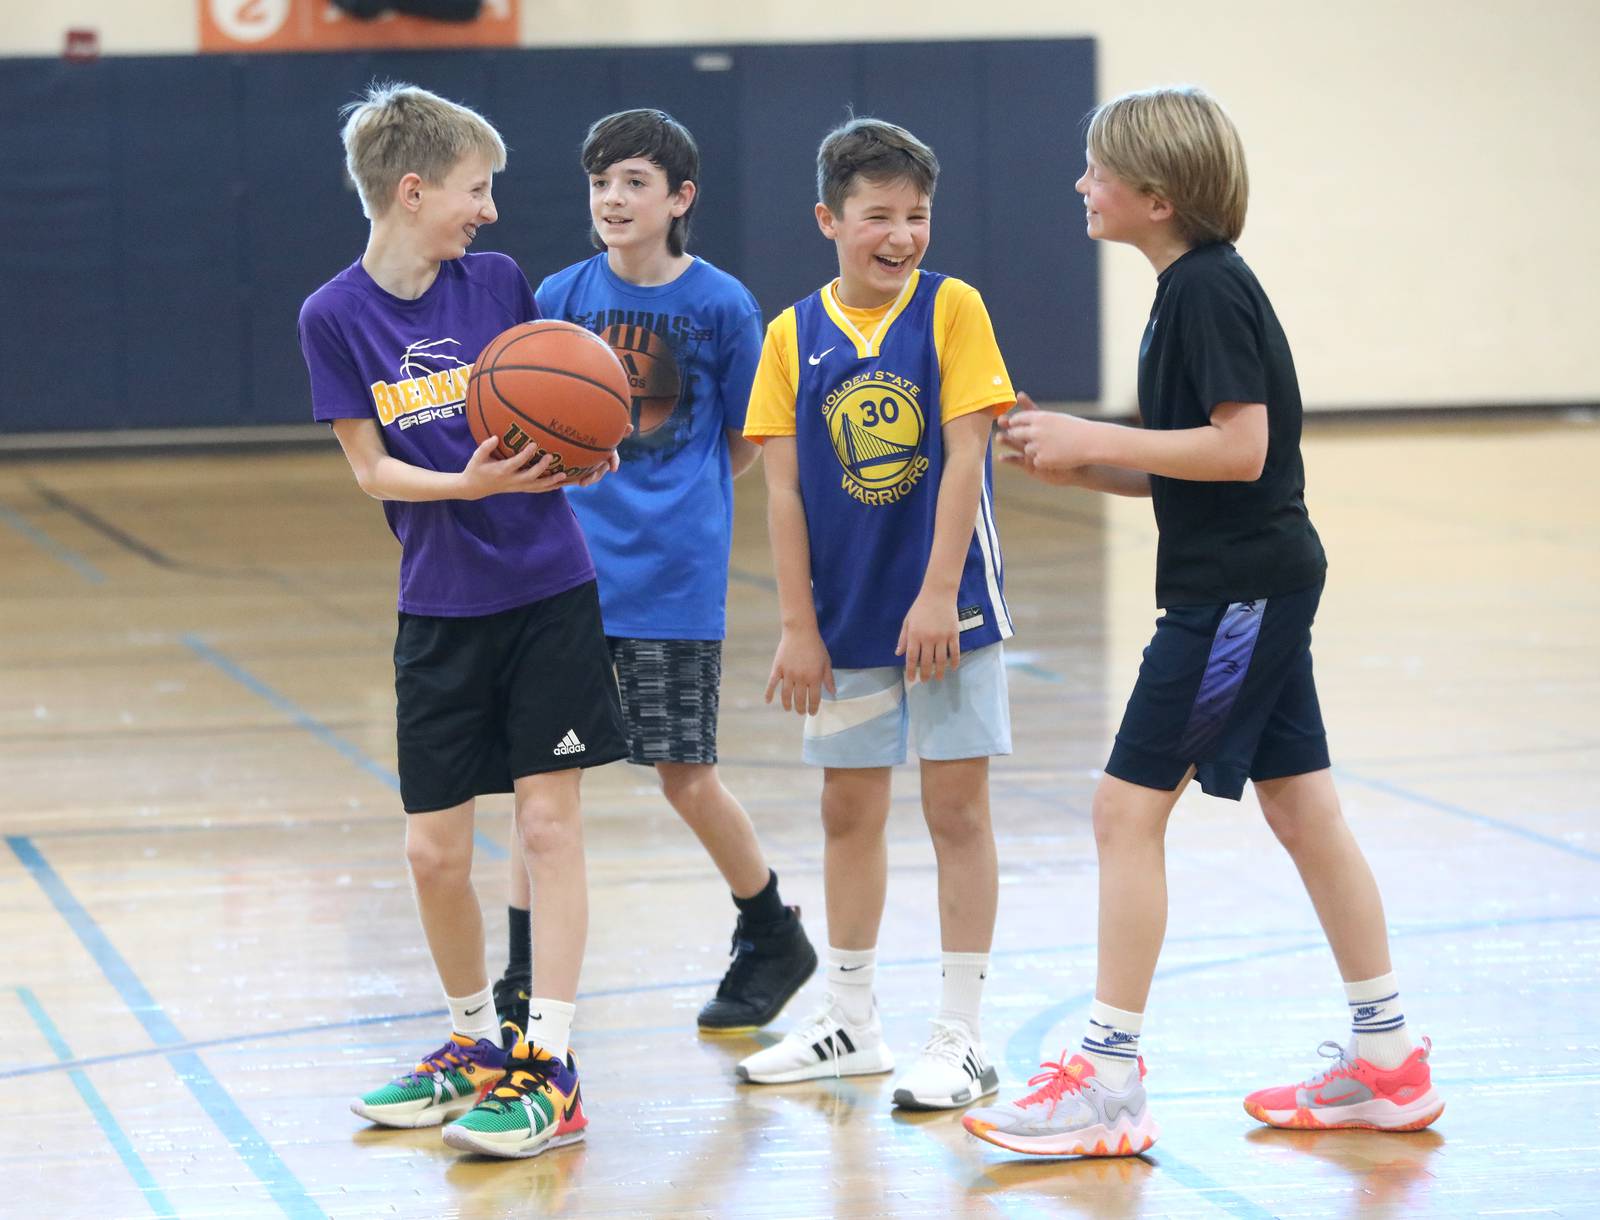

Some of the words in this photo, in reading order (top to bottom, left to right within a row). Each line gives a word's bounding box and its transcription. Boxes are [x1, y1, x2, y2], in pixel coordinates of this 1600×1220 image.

[371, 363, 474, 427] BREAKA
[821, 372, 871, 416] GOLDEN
[859, 396, 899, 428] 30
[841, 455, 929, 506] WARRIORS
[553, 743, 586, 755] adidas
